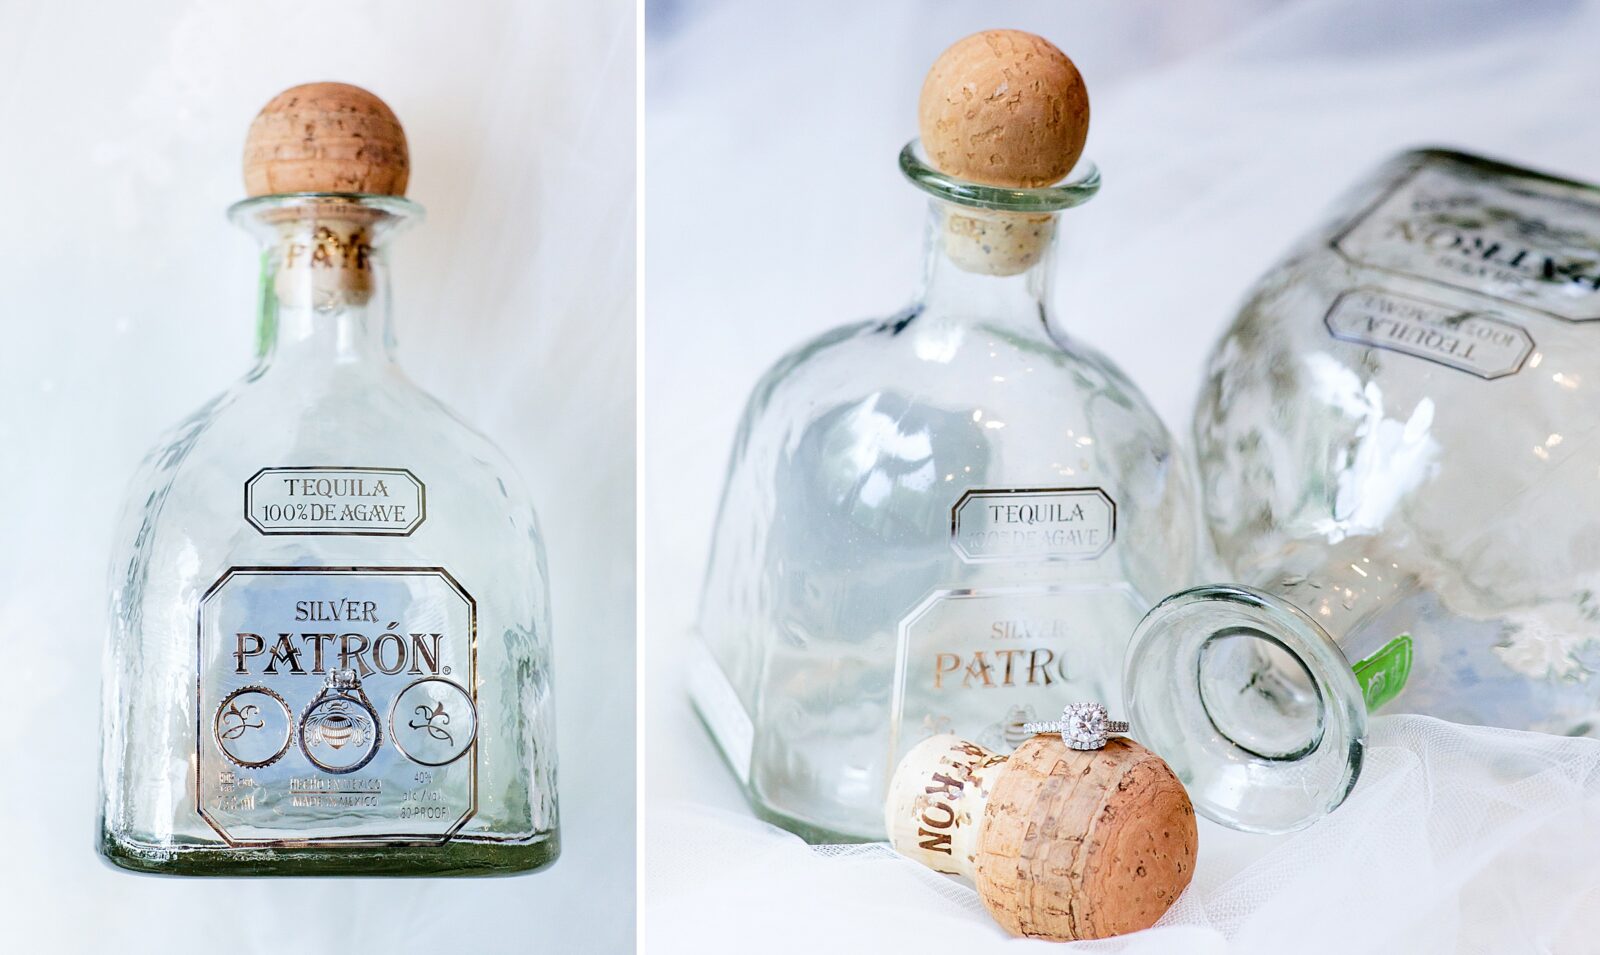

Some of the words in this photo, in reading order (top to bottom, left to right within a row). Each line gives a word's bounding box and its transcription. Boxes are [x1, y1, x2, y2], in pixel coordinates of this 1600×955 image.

[1360, 315, 1476, 361] TEQUILA
[284, 478, 390, 499] TEQUILA
[262, 503, 307, 521] 100%
[310, 503, 336, 521] DE
[340, 503, 406, 522] AGAVE
[989, 503, 1085, 525] TEQUILA
[1041, 528, 1099, 548] AGAVE
[295, 597, 379, 624] SILVER
[232, 621, 443, 679] PATRÓN
[290, 775, 324, 790] HECHO
[414, 771, 432, 784] 40%
[292, 795, 322, 807] MADE
[339, 795, 380, 807] MEXICO
